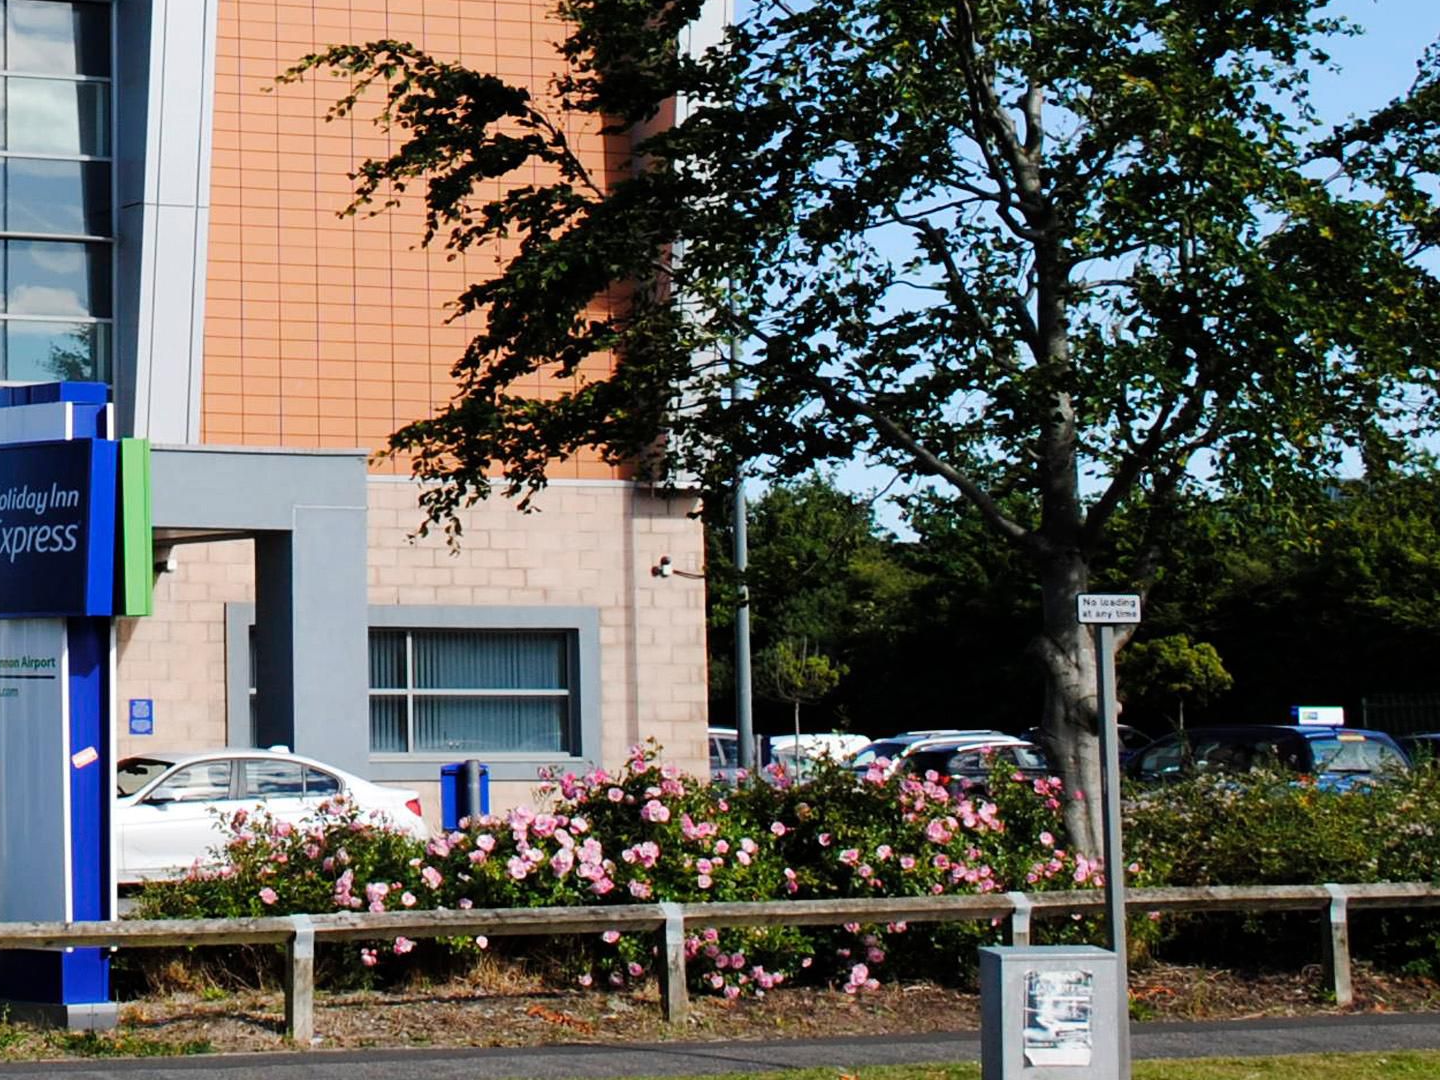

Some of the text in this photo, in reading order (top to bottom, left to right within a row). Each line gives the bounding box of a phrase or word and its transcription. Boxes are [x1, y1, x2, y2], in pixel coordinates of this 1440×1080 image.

[50, 482, 79, 508] Inn
[1083, 598, 1097, 606] No
[21, 655, 56, 670] Airport
